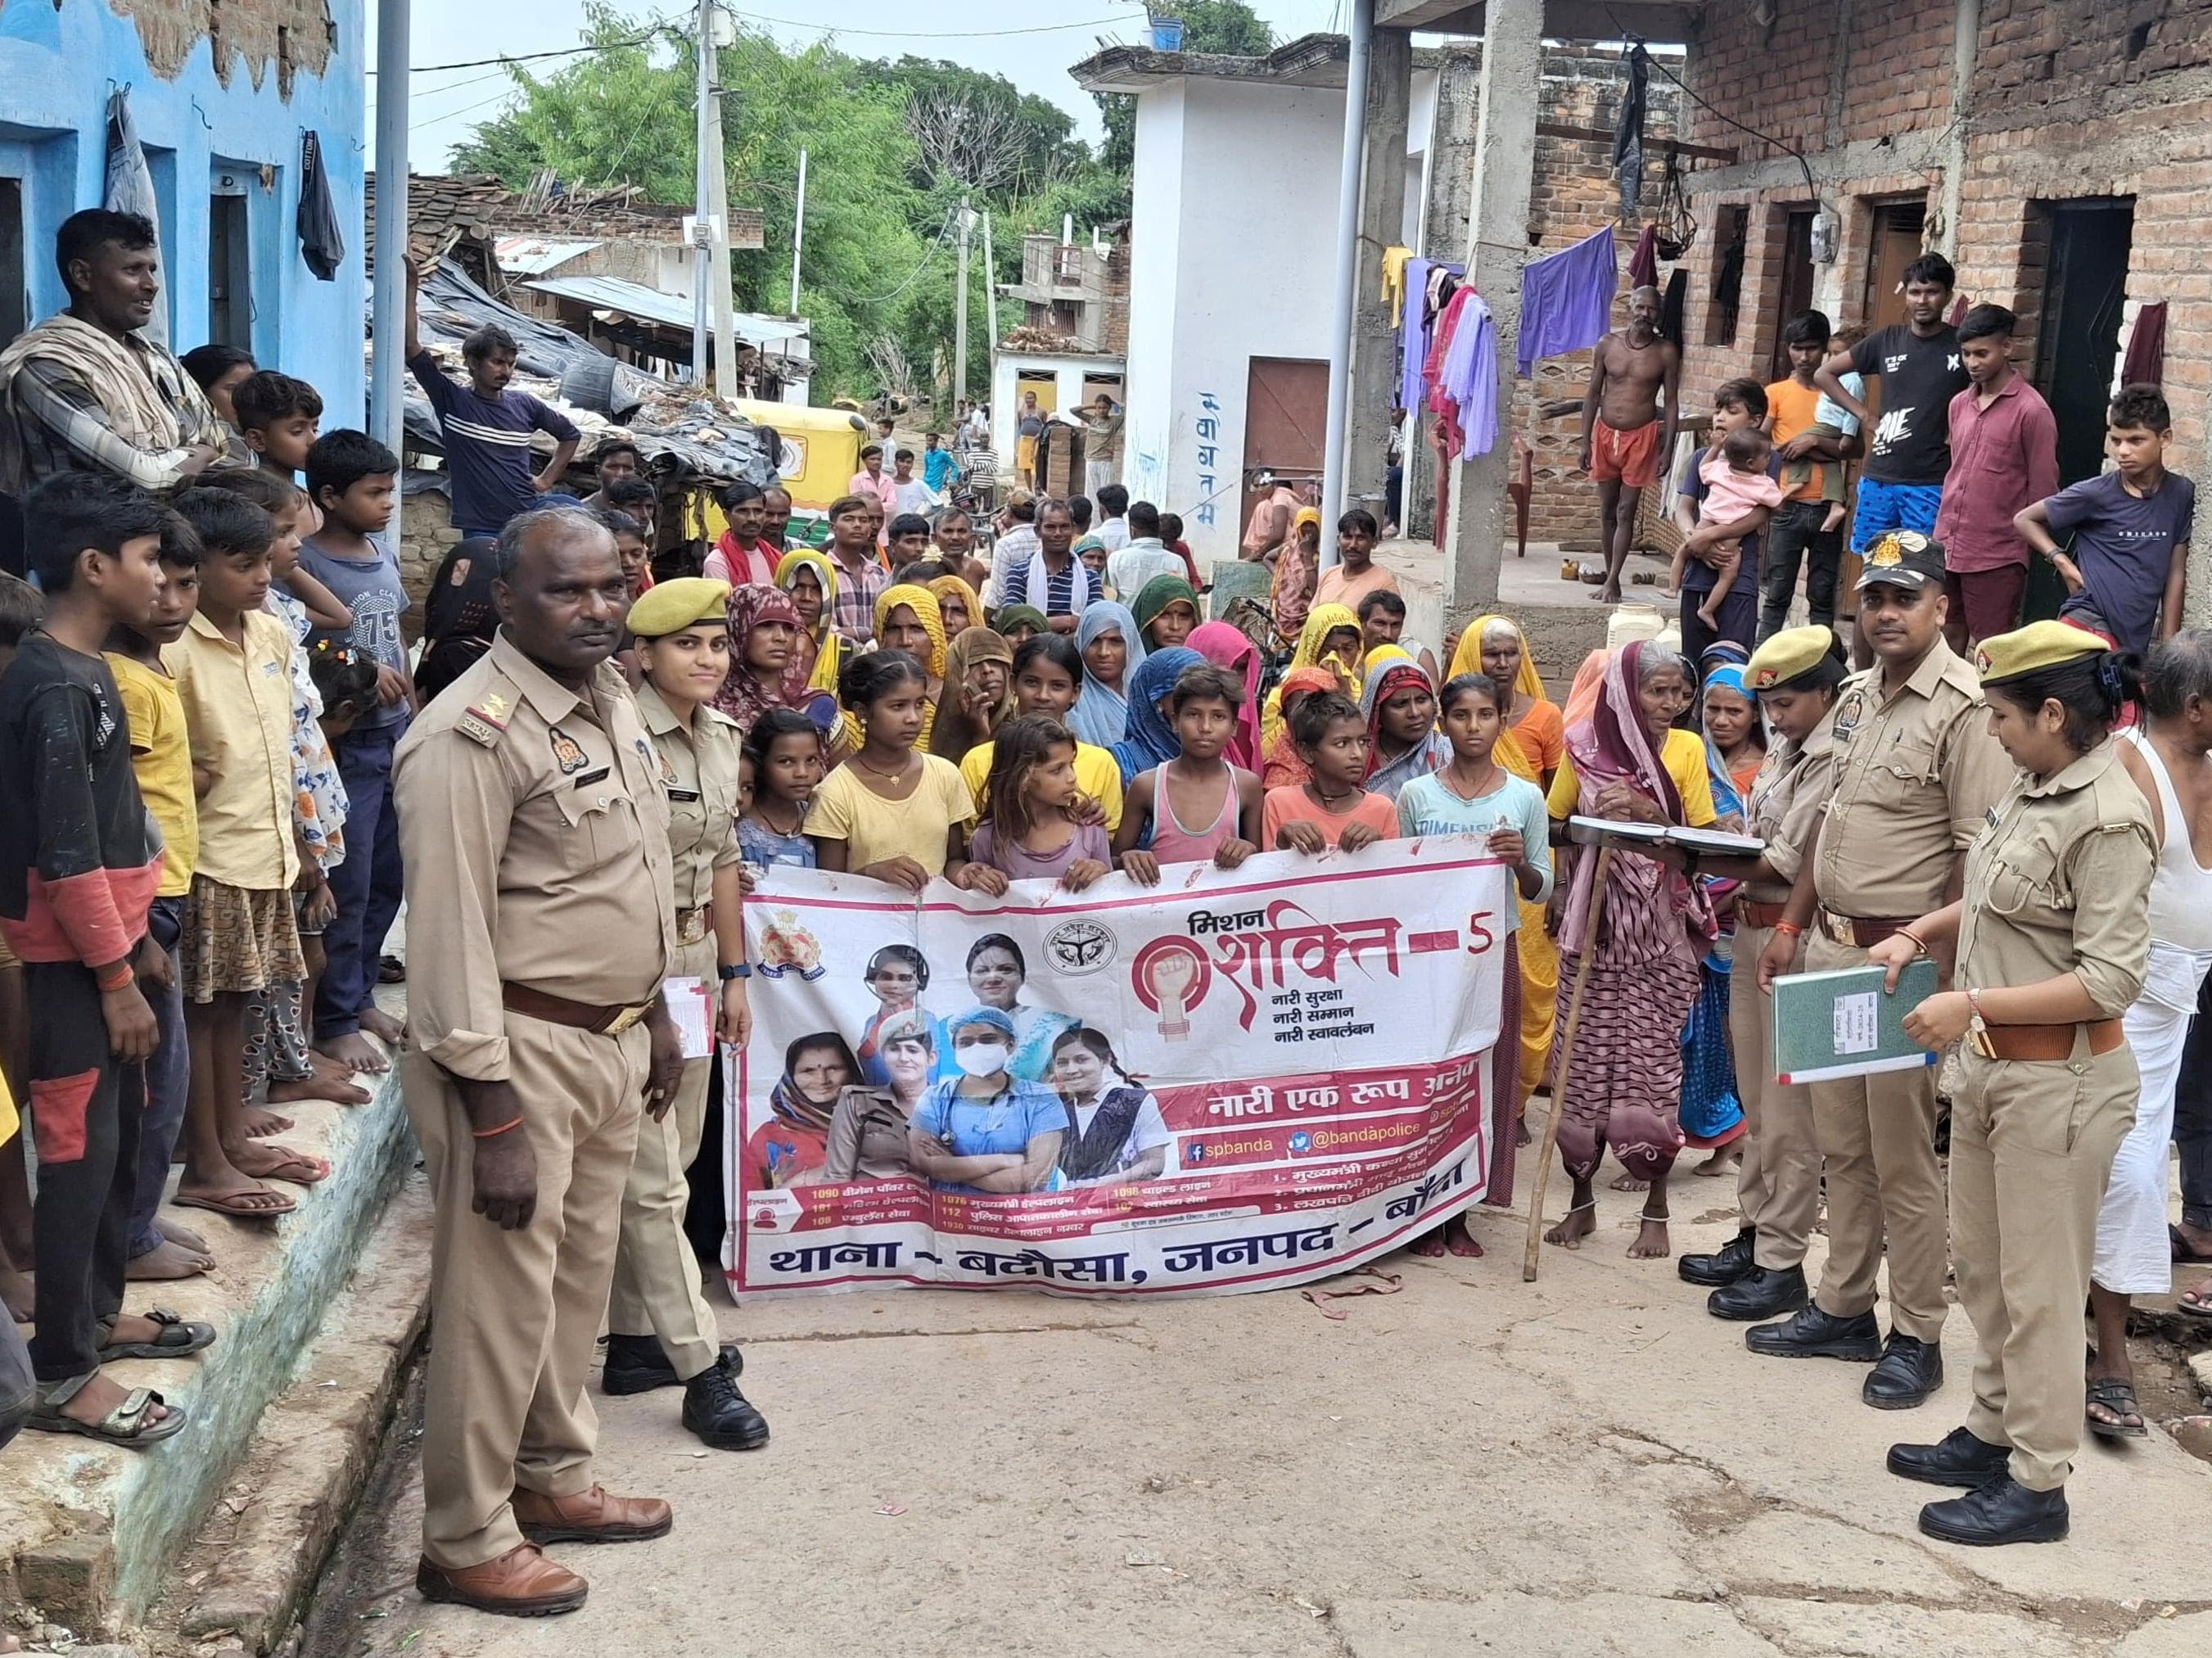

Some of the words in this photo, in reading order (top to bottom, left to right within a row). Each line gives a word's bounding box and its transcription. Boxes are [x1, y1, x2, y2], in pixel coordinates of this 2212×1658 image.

[304, 138, 314, 170] COTTON
[359, 608, 398, 649] 75
[1187, 908, 1266, 937] मिशन
[1271, 989, 1301, 1006] नारी
[1305, 989, 1343, 1009] सुरक्षा
[1273, 1008, 1302, 1025] नारी
[1307, 1006, 1355, 1023] सम्मान
[1274, 1026, 1303, 1043] नारी
[1307, 1021, 1375, 1041] स्वावलंबन
[1207, 1085, 1275, 1118] नारी
[1284, 1086, 1340, 1112] एक
[1348, 1078, 1411, 1105] रूप
[1312, 1123, 1421, 1149] @bandapolice
[1205, 1137, 1274, 1160] spbanda
[1292, 1163, 1361, 1183] मुख्यमंत्री
[810, 1188, 839, 1199] 1090
[941, 1195, 967, 1206] 1076
[1113, 1186, 1140, 1198] 1098
[1293, 1194, 1353, 1209] लखपति
[941, 1207, 961, 1218] 112
[969, 1210, 1003, 1222] पुलिस
[770, 1241, 903, 1274] थाना
[955, 1249, 1148, 1285] बदौसा,
[1162, 1222, 1340, 1273] जनपद
